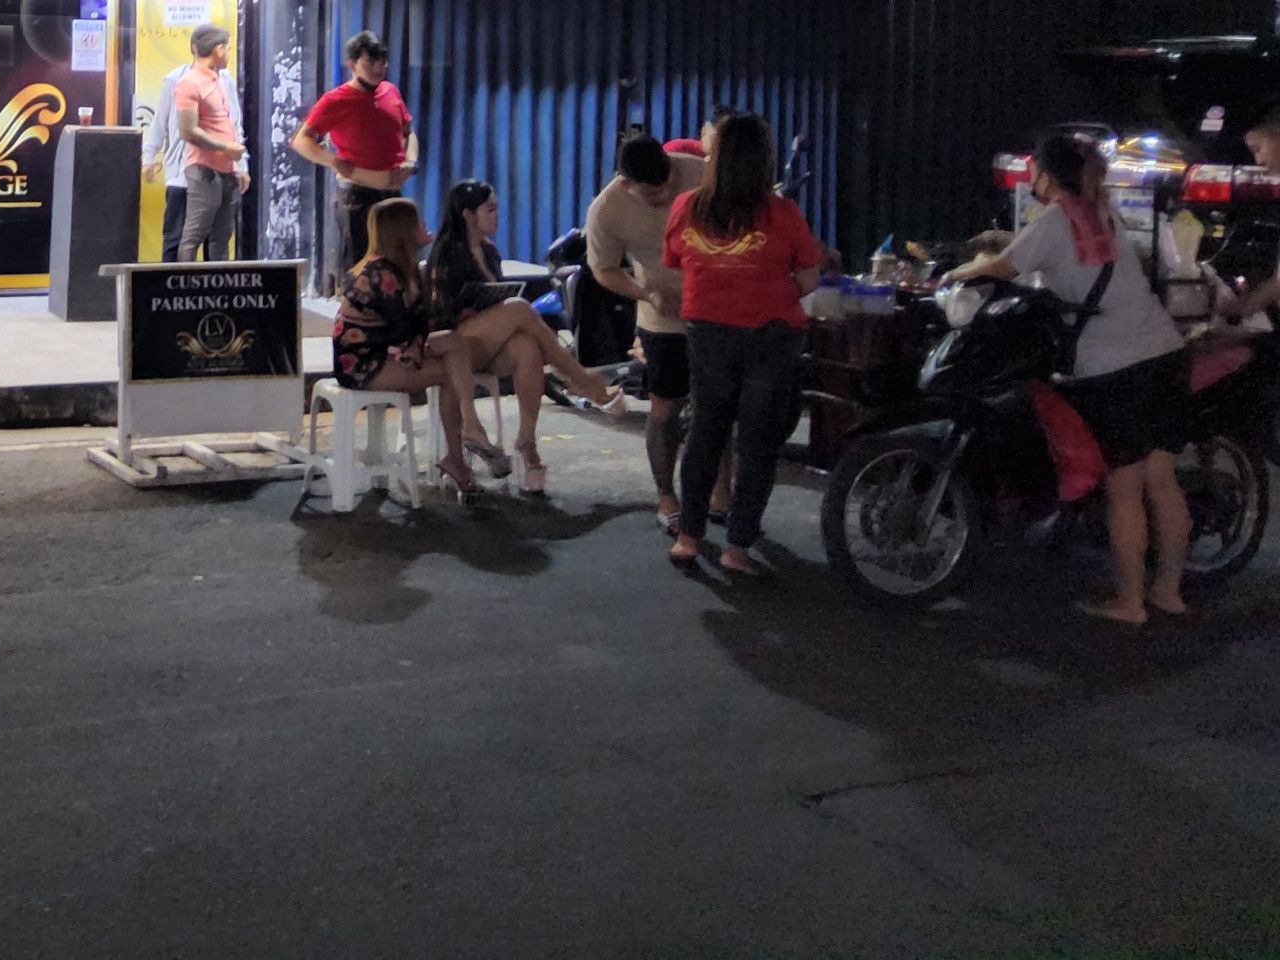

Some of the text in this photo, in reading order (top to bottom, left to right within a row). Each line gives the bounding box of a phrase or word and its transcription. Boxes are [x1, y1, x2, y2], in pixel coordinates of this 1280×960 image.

[166, 273, 264, 290] CUSTOMER
[151, 294, 279, 311] PARKING ONLY
